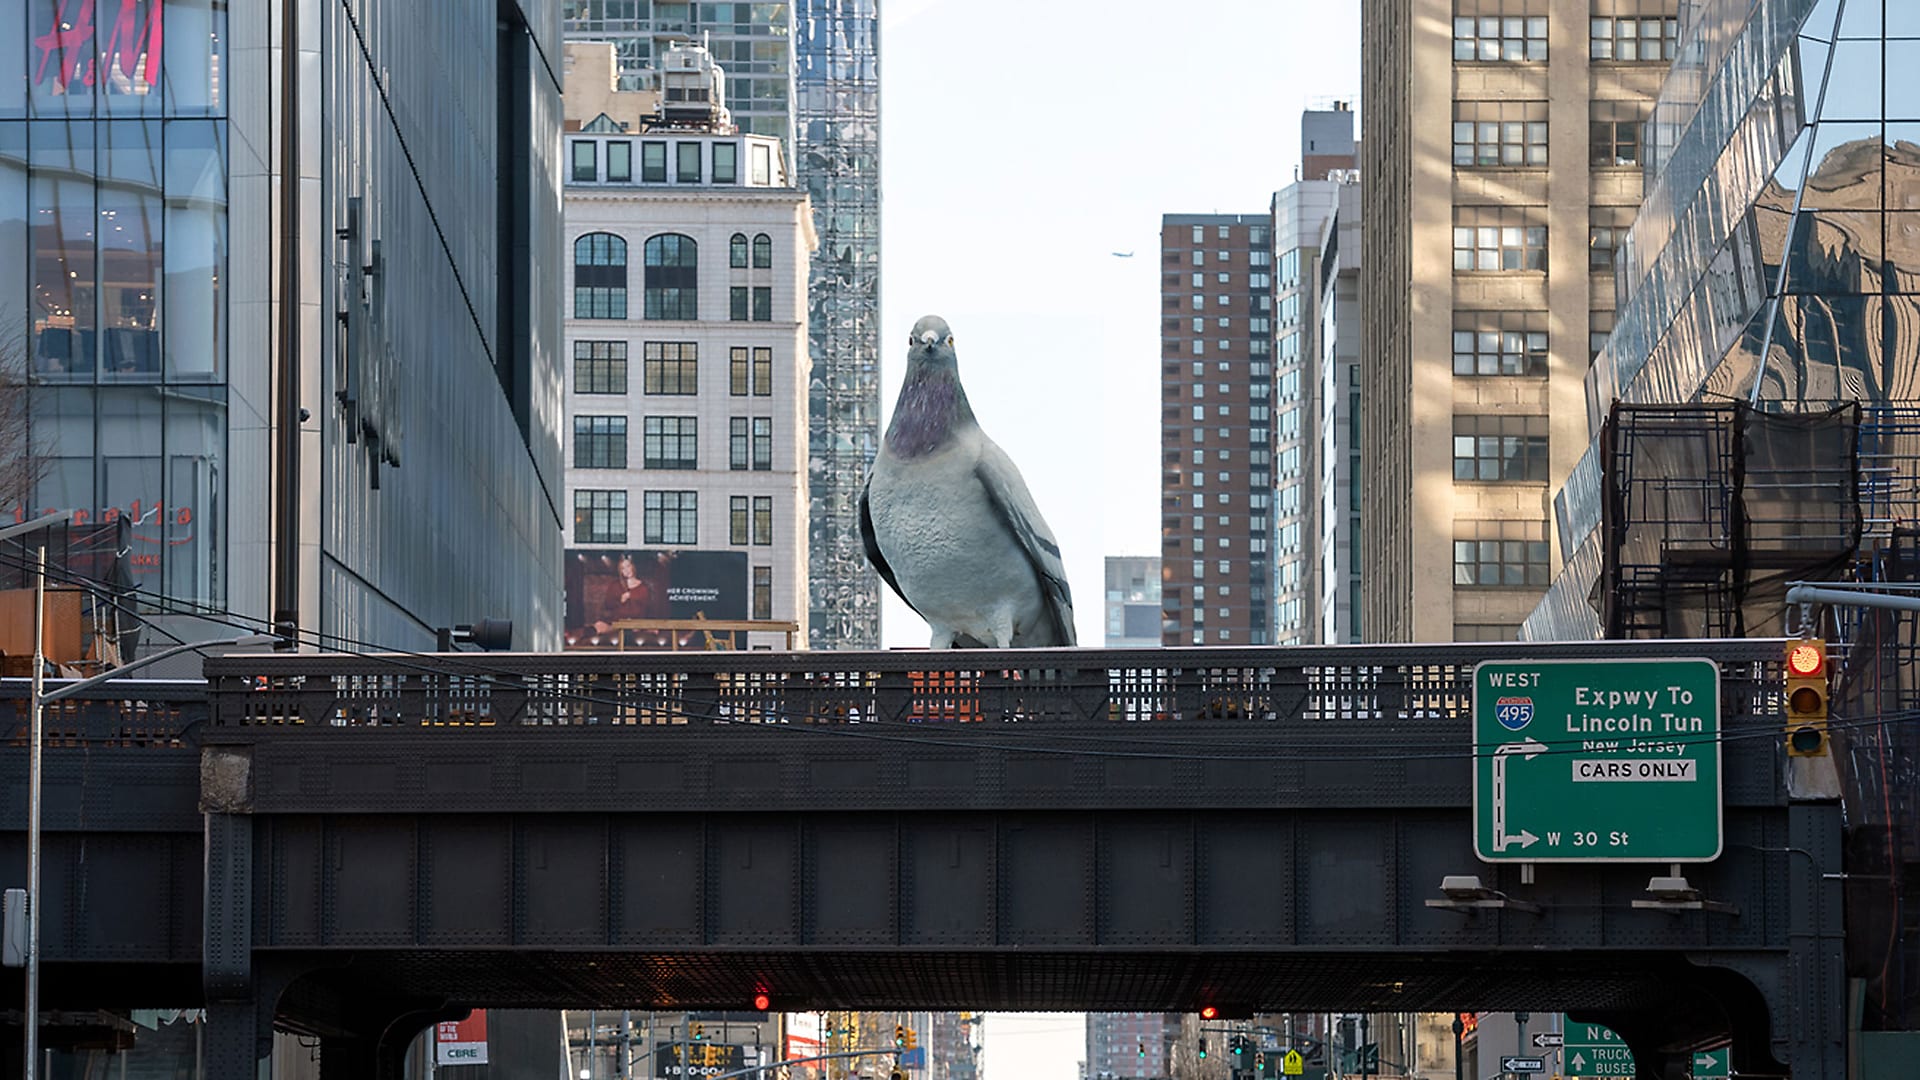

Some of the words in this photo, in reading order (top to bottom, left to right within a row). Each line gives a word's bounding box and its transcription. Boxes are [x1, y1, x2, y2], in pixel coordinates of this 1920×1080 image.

[34, 0, 163, 92] H&M
[1489, 673, 1541, 687] WEST
[1575, 687, 1658, 709] Expwy
[1667, 686, 1693, 705] To
[1499, 706, 1530, 721] 495
[1566, 714, 1652, 732] Lincoln
[1660, 713, 1703, 732] Tun
[1583, 740, 1619, 753] New
[1626, 739, 1686, 756] Jersey
[1580, 763, 1632, 777] CARS
[1639, 763, 1690, 777] ONLY
[1547, 832, 1561, 846] W
[1573, 832, 1598, 846] 30
[1609, 831, 1629, 846] St
[447, 1049, 477, 1058] CBRE
[699, 1046, 734, 1056] RNT
[1596, 1063, 1636, 1074] BUSES
